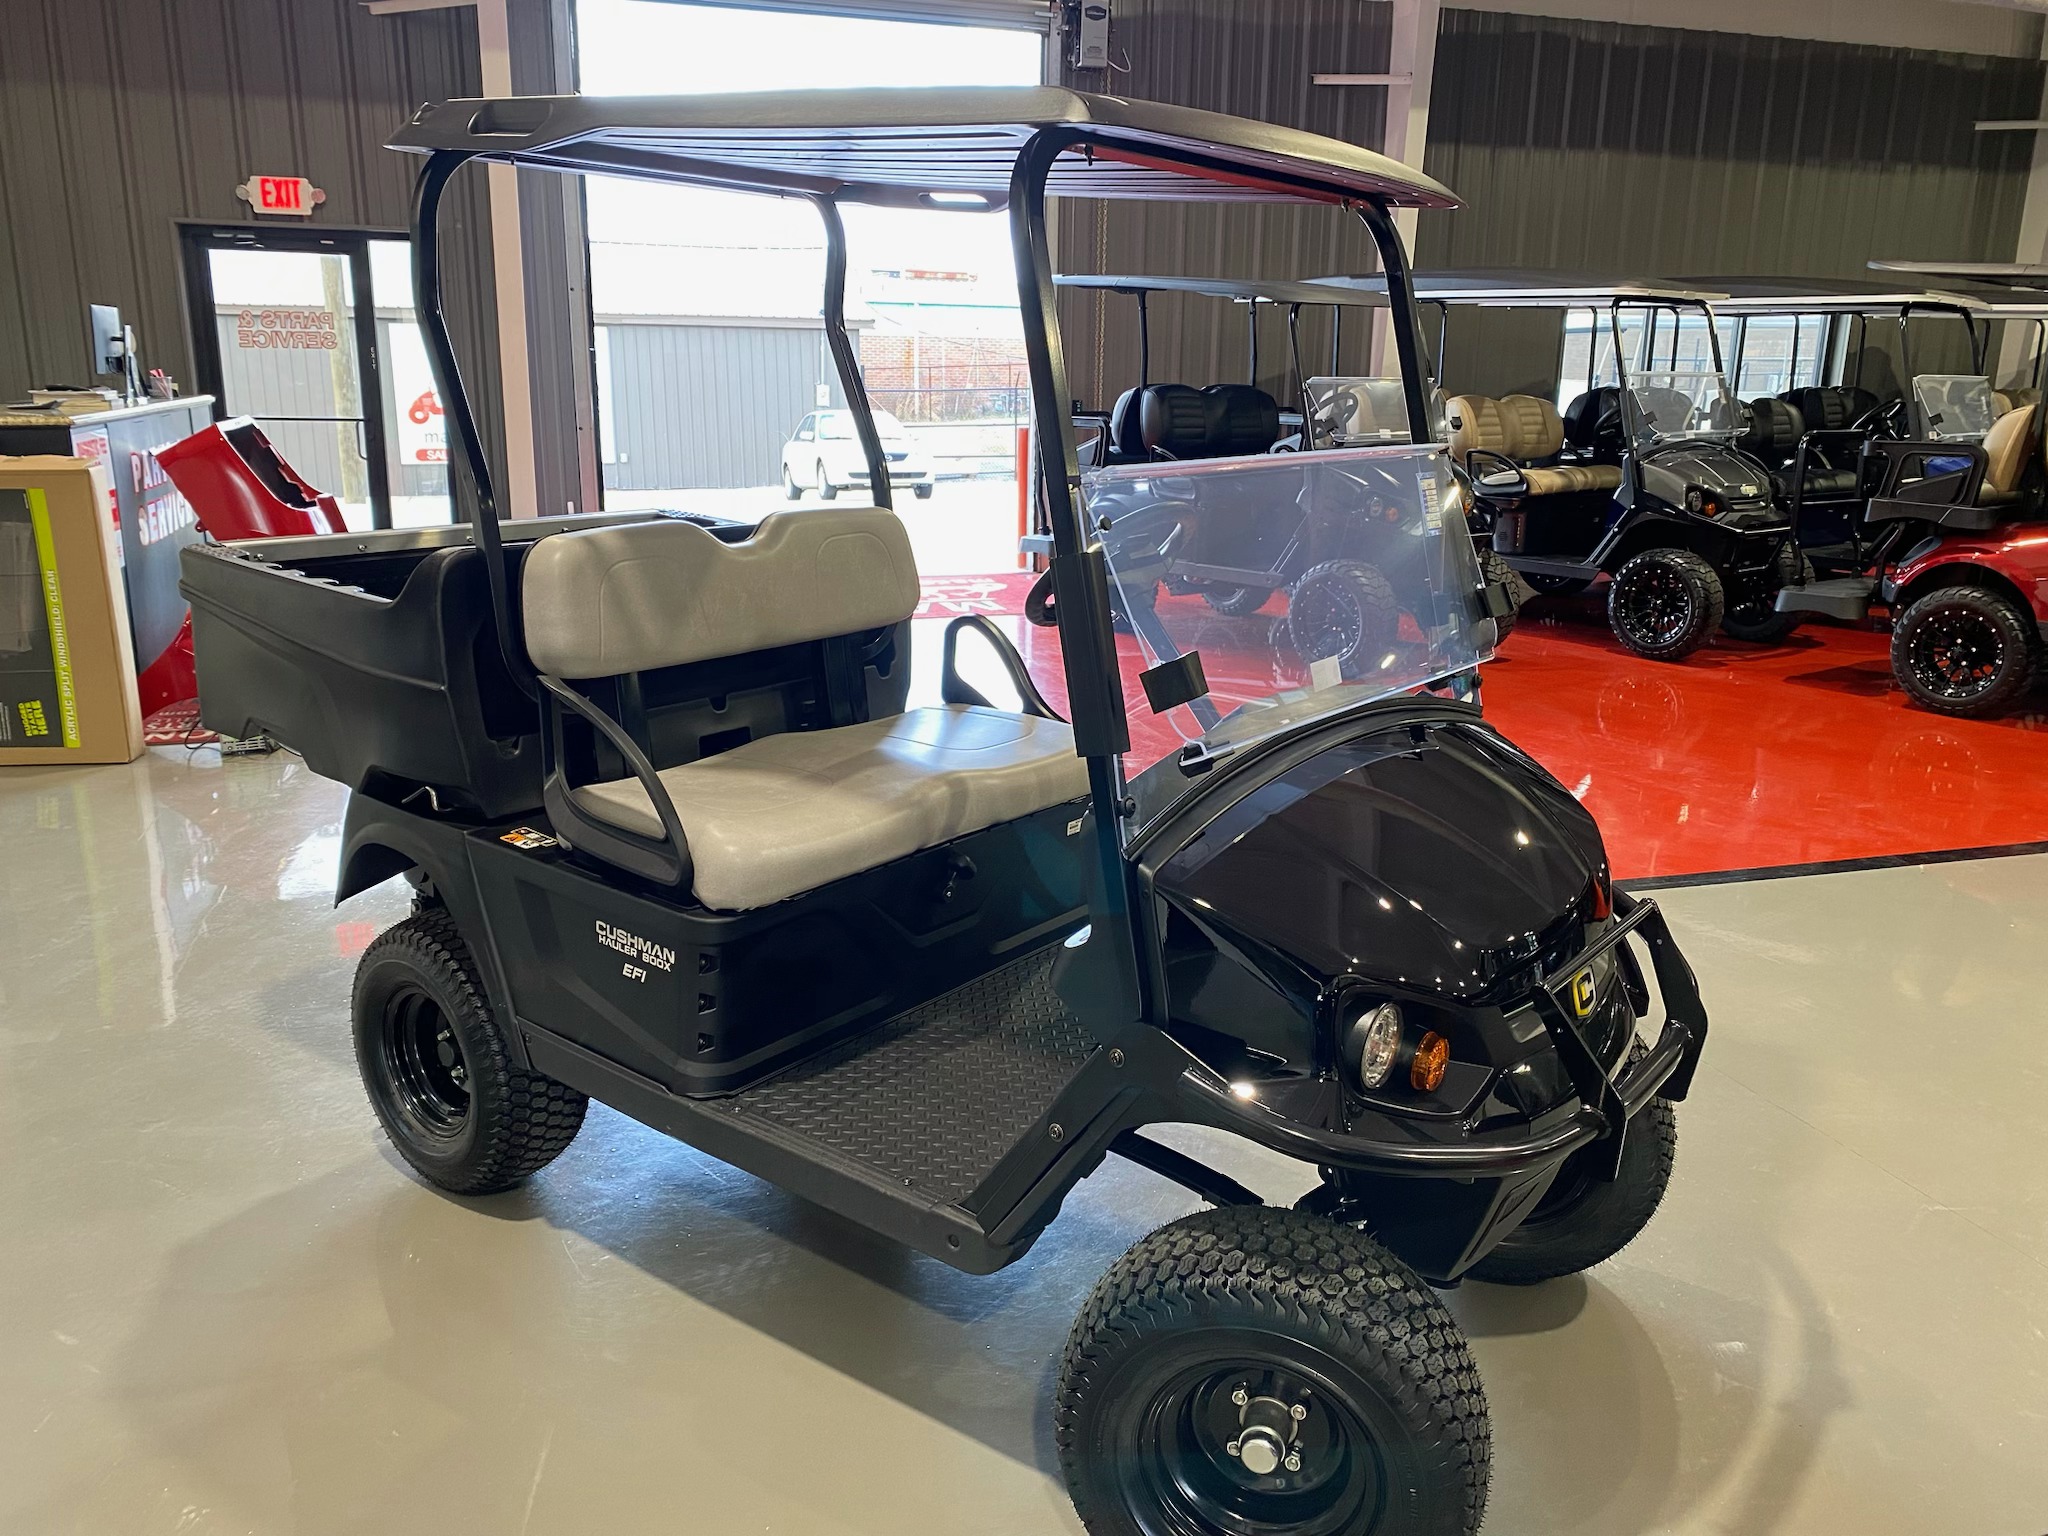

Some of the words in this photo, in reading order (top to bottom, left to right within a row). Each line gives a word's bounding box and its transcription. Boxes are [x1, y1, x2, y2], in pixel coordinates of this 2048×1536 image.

[260, 178, 301, 209] EXIT
[46, 570, 58, 602] CLEAR
[52, 604, 69, 668] WINDSHIELD:
[61, 670, 74, 698] SPLIT
[18, 702, 33, 737] RUGGED
[24, 702, 39, 735] STARTS
[31, 700, 48, 735] HERE
[65, 699, 77, 741] ACRYLIC
[595, 920, 676, 966] CUSHMAN
[598, 935, 638, 959] HAULER
[642, 952, 671, 973] 800X
[622, 962, 647, 983] EFI
